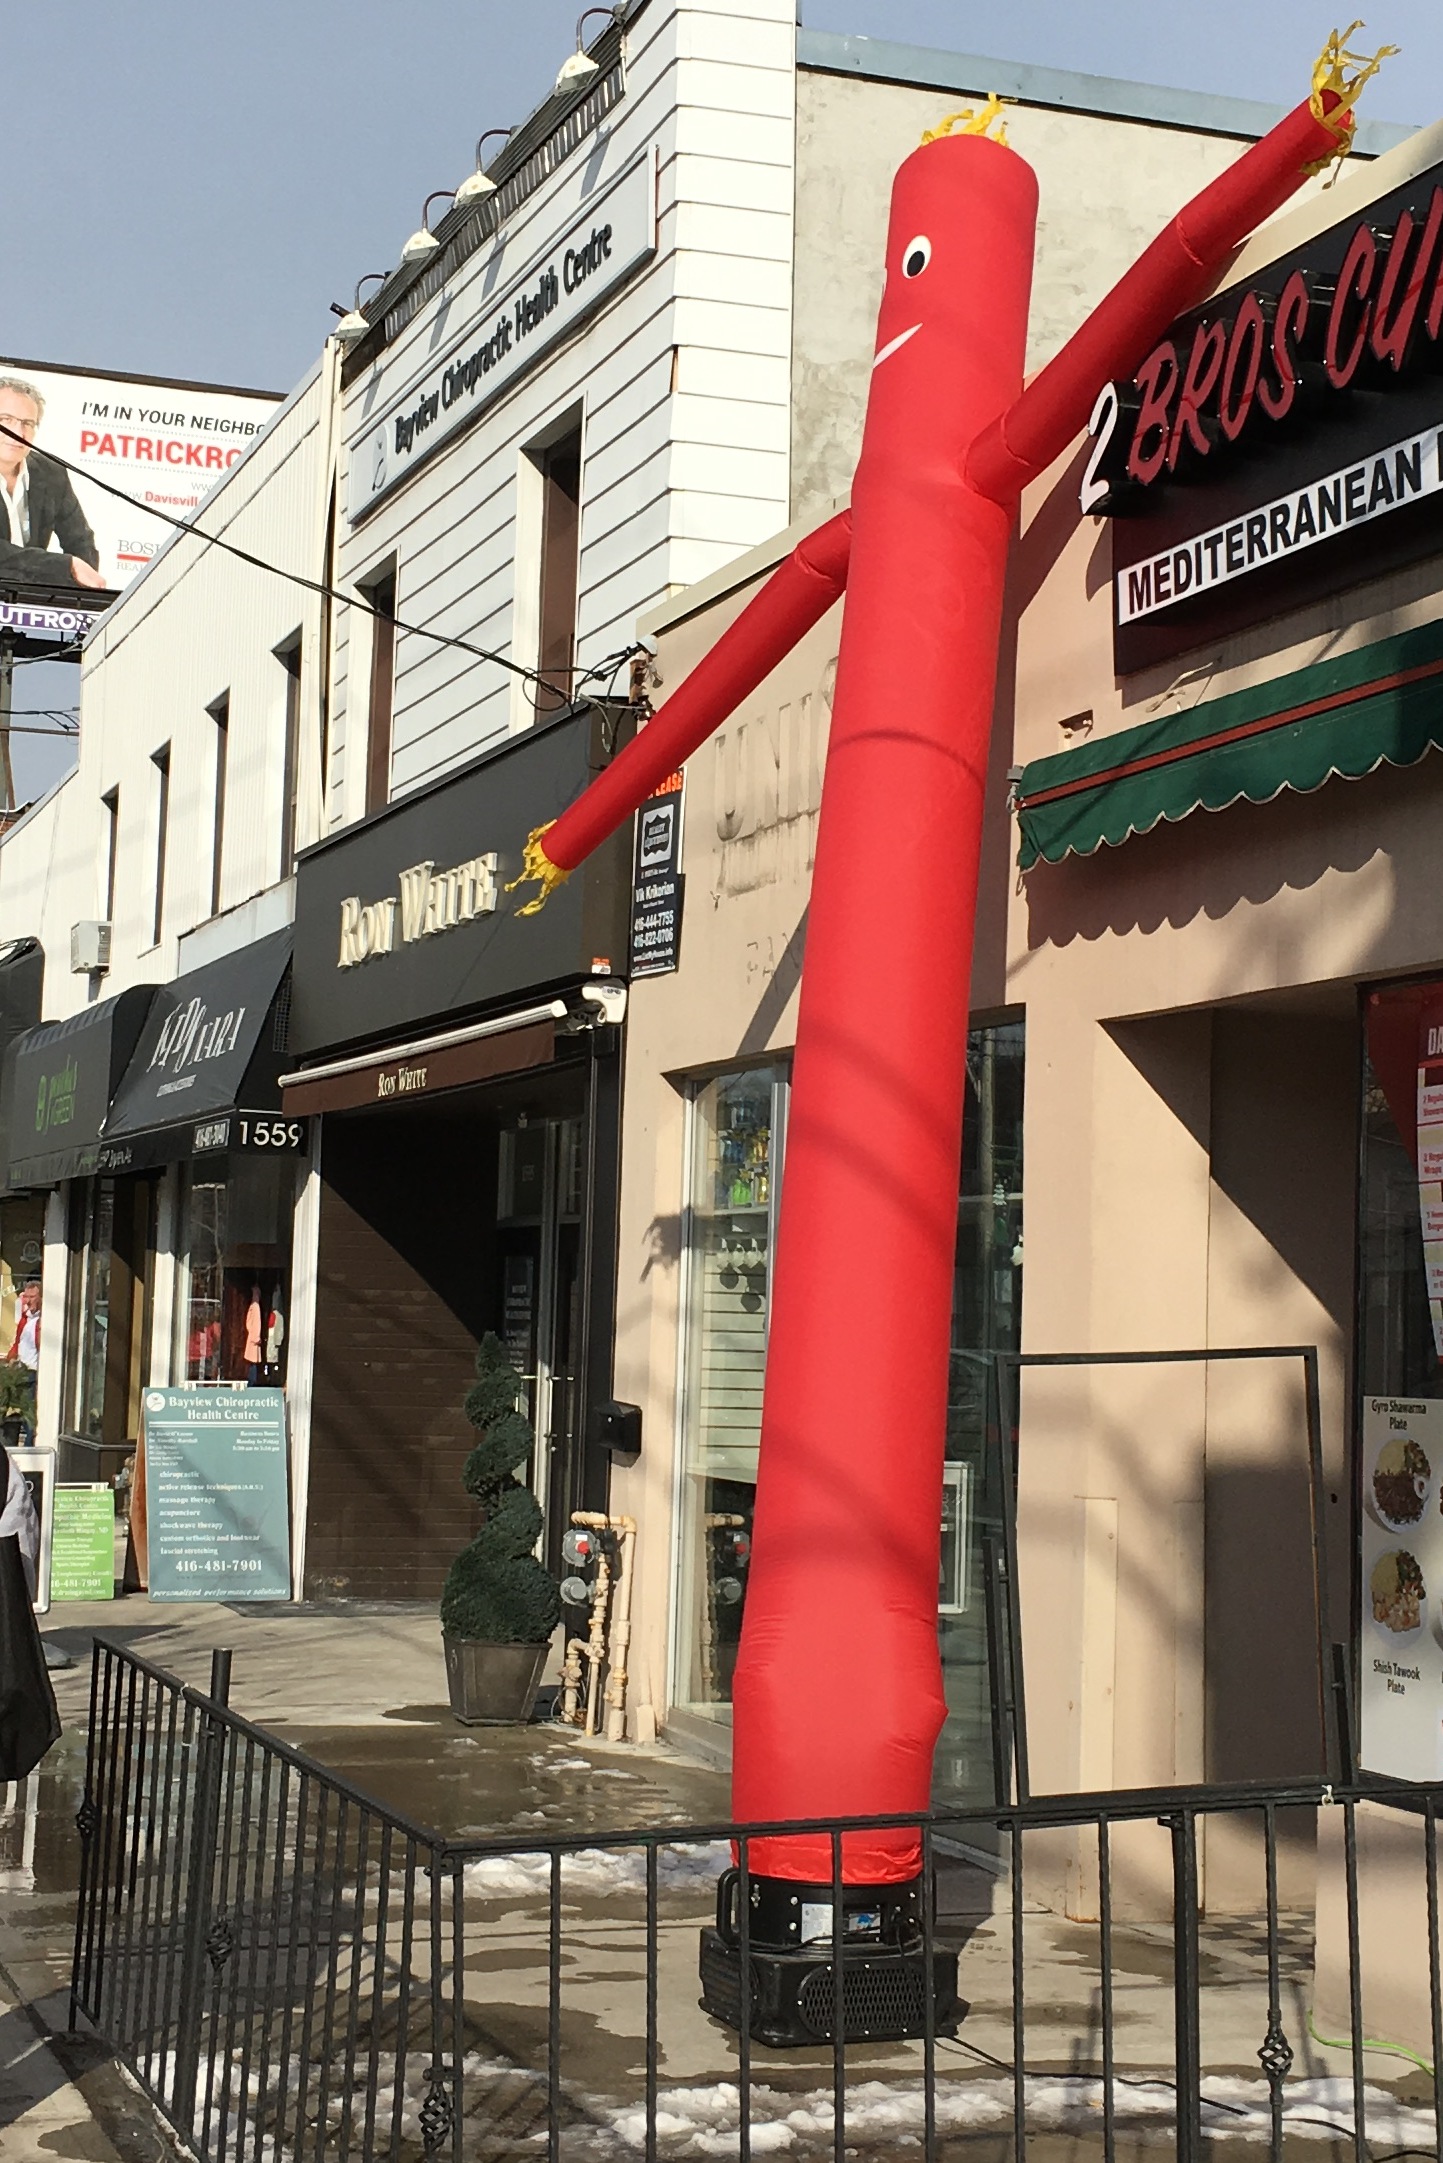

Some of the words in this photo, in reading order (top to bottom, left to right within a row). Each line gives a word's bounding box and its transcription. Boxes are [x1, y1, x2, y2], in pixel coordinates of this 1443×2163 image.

[394, 389, 440, 455] Bayview
[441, 315, 513, 411] Chiropractic
[514, 264, 560, 342] Health
[563, 223, 612, 296] Centre
[1079, 381, 1118, 515] 2
[1127, 270, 1310, 486] BROS
[1324, 184, 1443, 389] CU
[81, 401, 109, 418] I'M
[114, 406, 133, 421] IN
[138, 408, 186, 428] YOUR
[144, 491, 200, 507] Davisvill
[1127, 441, 1422, 615] MEDITERRANEAN
[337, 896, 397, 969] RON
[398, 851, 498, 943] WHITE
[378, 1072, 397, 1098] RON
[398, 1066, 428, 1092] WHITE
[239, 1120, 304, 1148] 1559
[169, 1397, 213, 1408] Bayview
[216, 1396, 279, 1408] Chiropractic
[1389, 1399, 1427, 1415] Shawarma
[187, 1410, 222, 1420] Health
[224, 1410, 259, 1420] Centre
[1389, 1417, 1407, 1430] Plate
[198, 1522, 223, 1530] therapy
[175, 1560, 262, 1572] 416-481-7901
[153, 1589, 201, 1597] personalized
[204, 1589, 252, 1597] performance
[1373, 1659, 1392, 1675] Shish
[1393, 1663, 1420, 1681] Tawook
[1387, 1678, 1406, 1695] Plate
